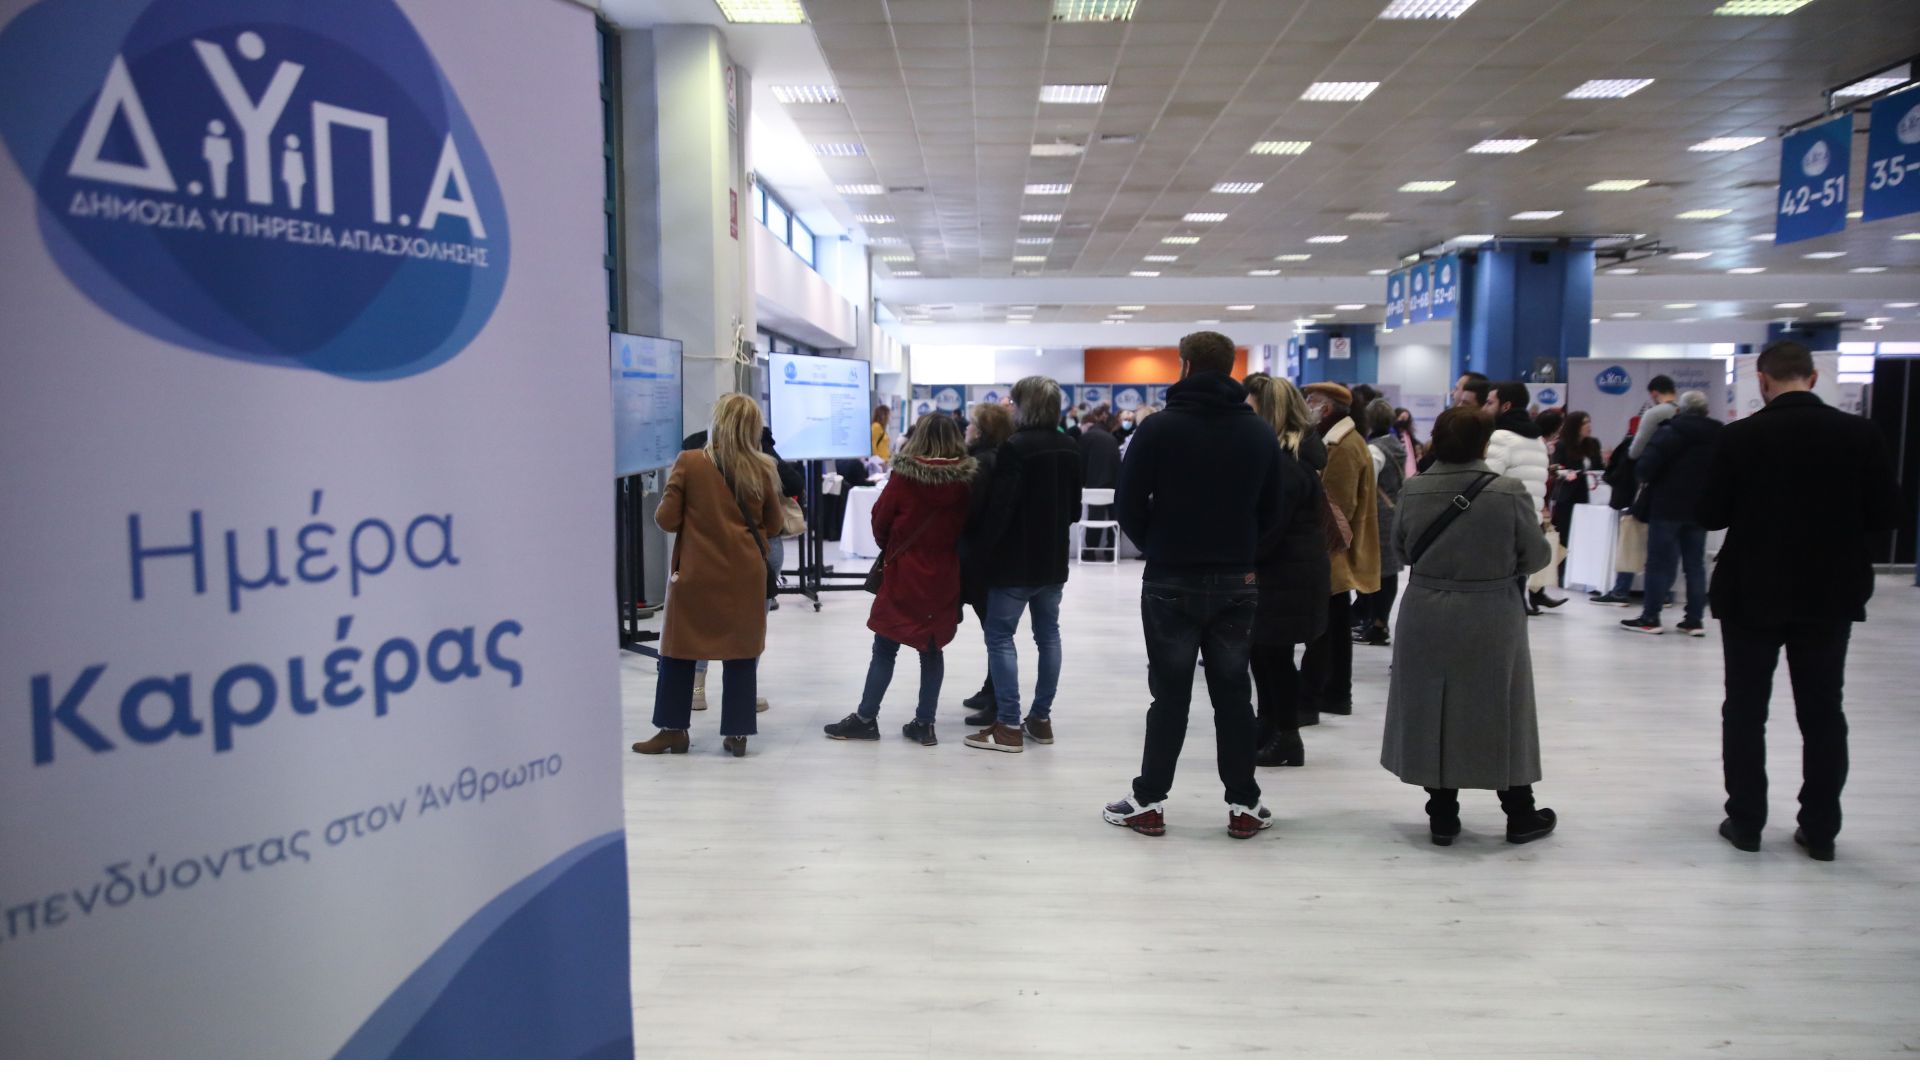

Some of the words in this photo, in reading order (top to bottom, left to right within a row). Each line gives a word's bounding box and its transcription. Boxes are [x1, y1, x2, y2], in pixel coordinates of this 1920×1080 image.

[68, 190, 206, 231] ΔΗΜΟΣΙΑ
[210, 208, 336, 247] ΥΠΗΡΕΣΙΑ
[339, 228, 490, 268] ΑΠΑΣΧΟΛΗΣΗΣ
[1780, 174, 1845, 217] 42-51
[127, 489, 460, 613] Ημέρα
[30, 615, 524, 766] Καριέρας
[0, 827, 312, 945] πενδύοντας
[323, 796, 409, 846] στον
[416, 752, 563, 815] Άνθρωπο
